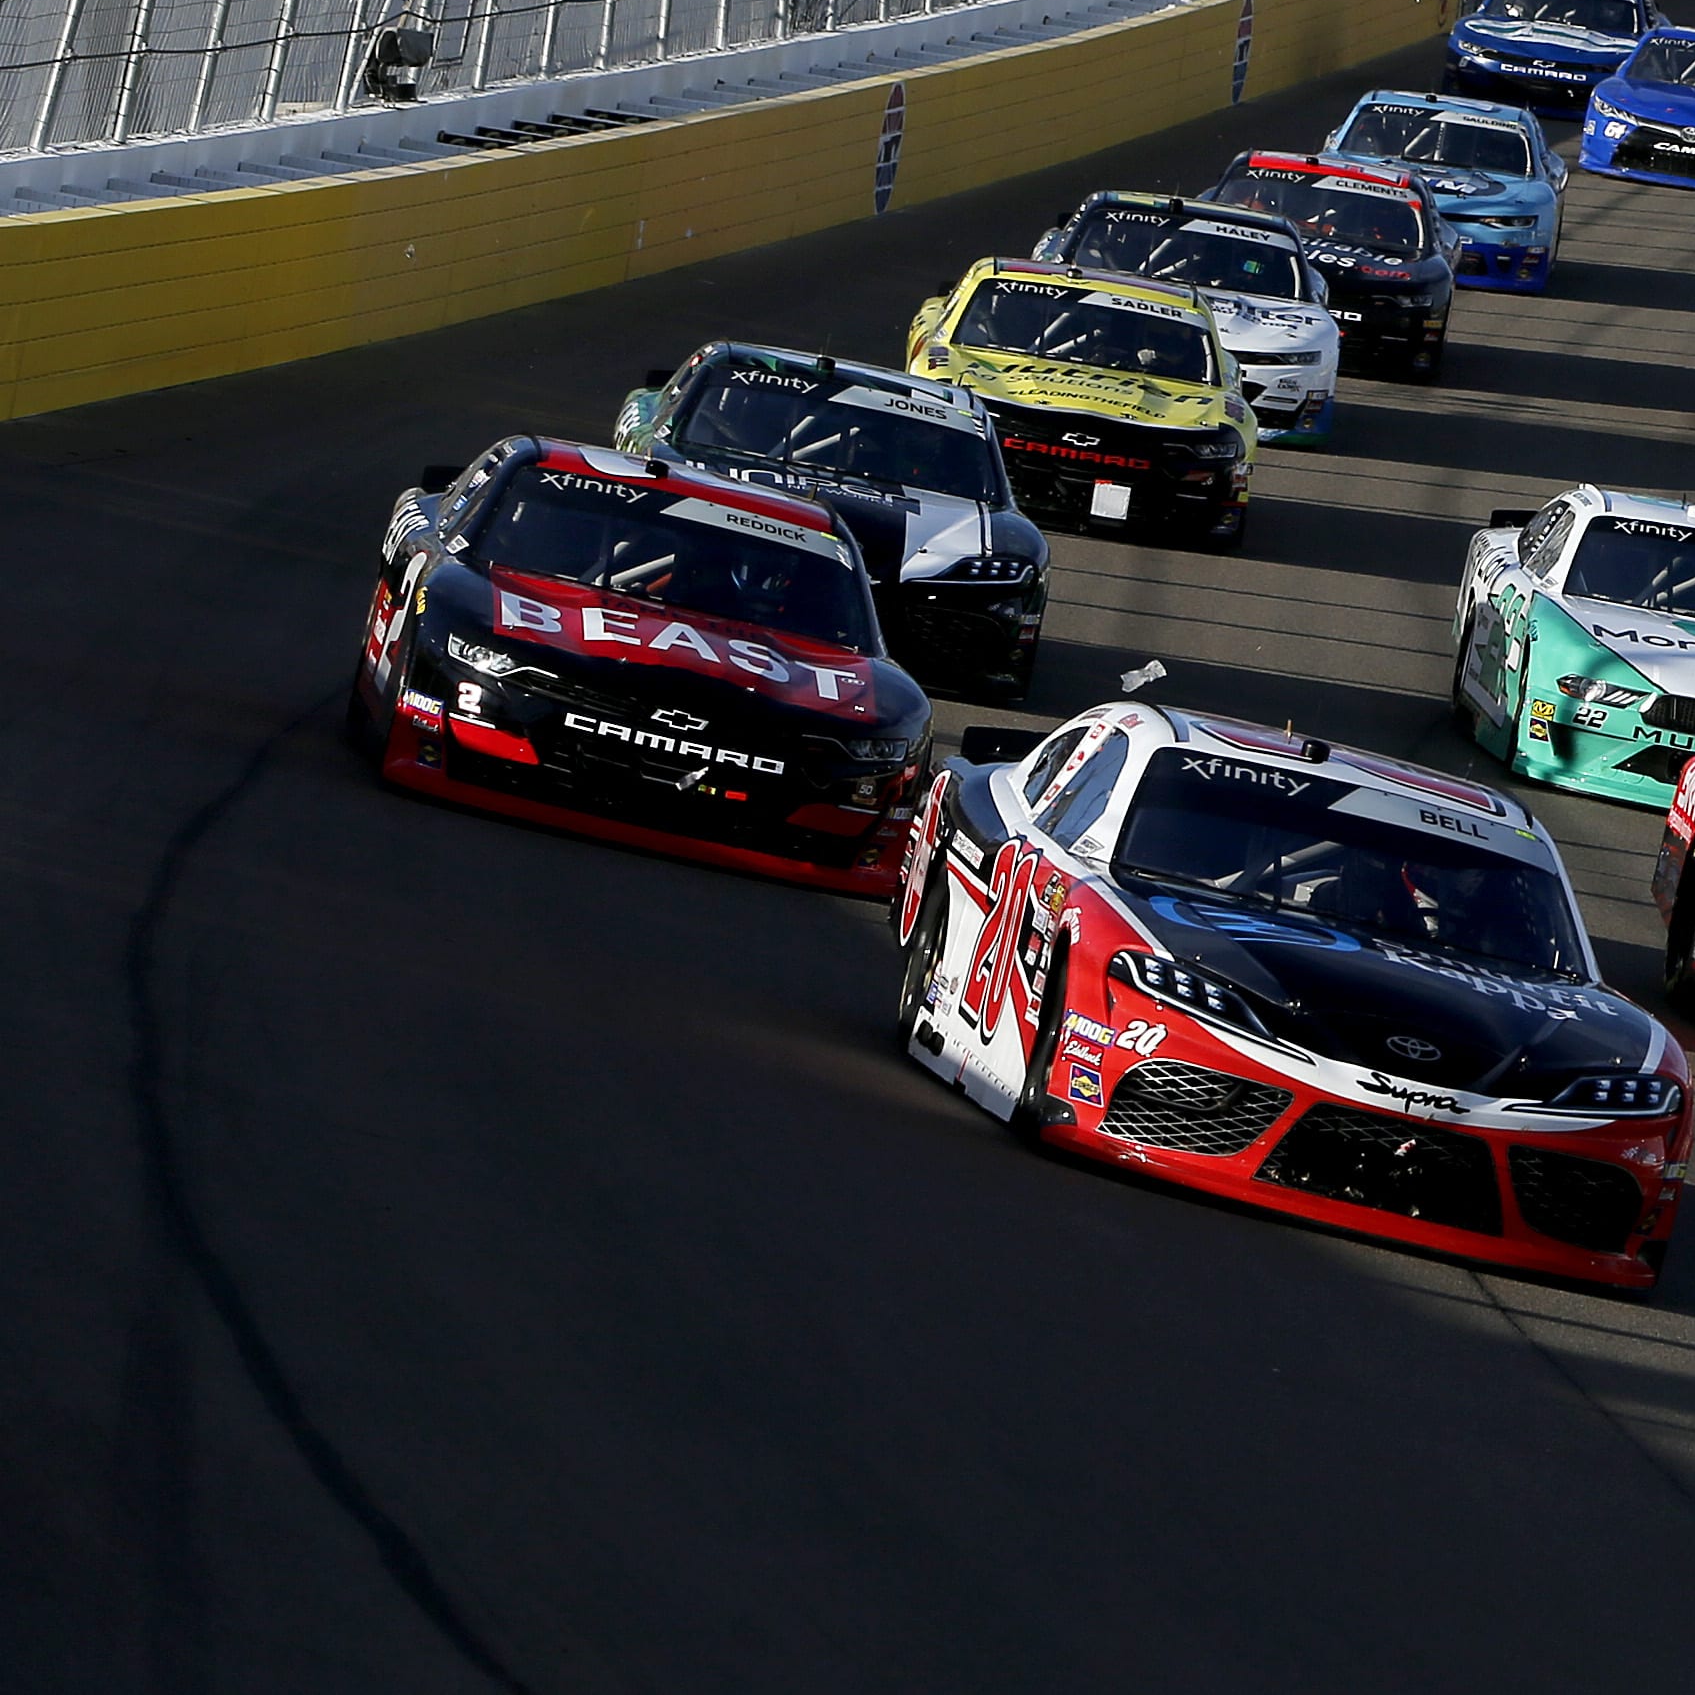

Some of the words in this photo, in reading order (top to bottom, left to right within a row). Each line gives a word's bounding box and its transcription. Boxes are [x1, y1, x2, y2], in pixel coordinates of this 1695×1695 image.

[1500, 62, 1588, 82] CAMARO
[1372, 104, 1425, 117] xfinity
[1247, 168, 1307, 184] xfinity
[1335, 179, 1409, 200] CLEMENTS
[1105, 210, 1171, 228] xfinity
[1215, 224, 1272, 242] HALEY
[995, 281, 1069, 300] xfinity
[1111, 297, 1184, 319] SADLER
[730, 369, 819, 394] xfinity
[884, 398, 948, 421] JONES
[1003, 437, 1151, 471] CAMARO
[540, 471, 649, 504] xfinity
[726, 512, 807, 543] REDDICK
[1612, 519, 1693, 542] xfinity
[500, 592, 858, 701] BEAST
[457, 681, 482, 714] 2
[1572, 706, 1608, 728] 22
[564, 712, 785, 775] CAMARO
[1182, 756, 1312, 797] xfinity
[858, 784, 873, 795] 50
[1420, 809, 1490, 841] BELL
[959, 837, 1044, 1046] 20
[1062, 1013, 1115, 1045] MOOG
[1115, 1019, 1168, 1057] 20
[1356, 1070, 1471, 1114] Supra
